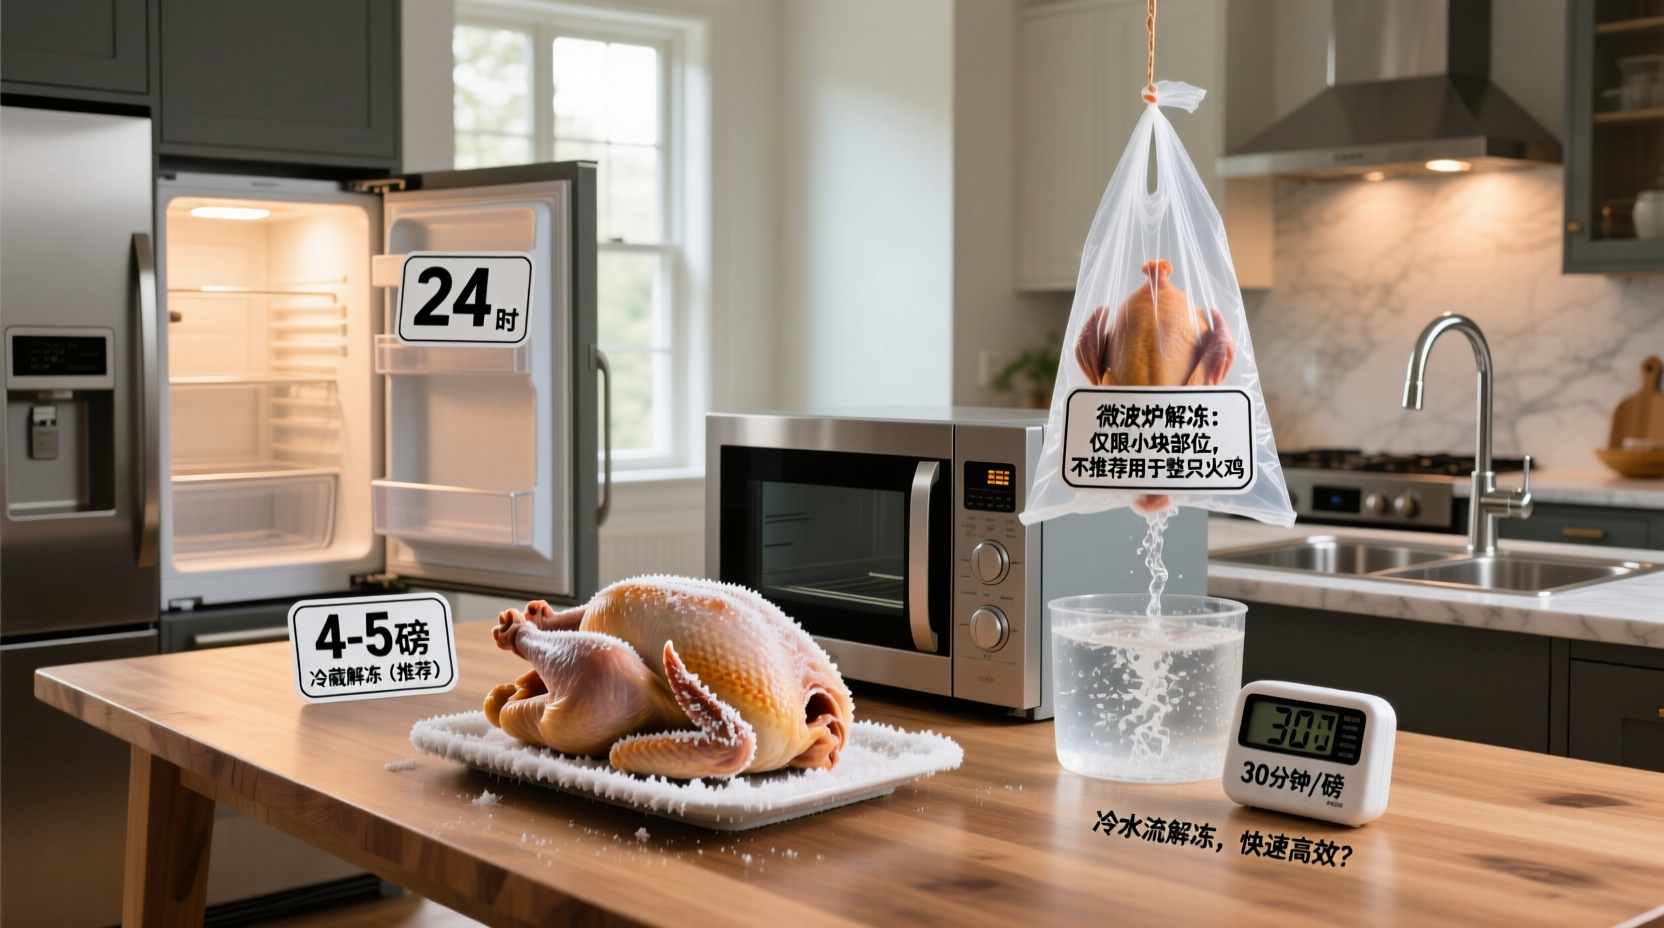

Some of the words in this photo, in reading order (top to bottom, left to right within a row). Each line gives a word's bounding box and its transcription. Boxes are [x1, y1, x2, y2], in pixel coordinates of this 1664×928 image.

[413, 266, 519, 332] 24时
[1070, 456, 1245, 479] 不推荐用于整只火鸡
[315, 611, 430, 659] 4-5磅
[1240, 761, 1345, 799] 30分钟/磅
